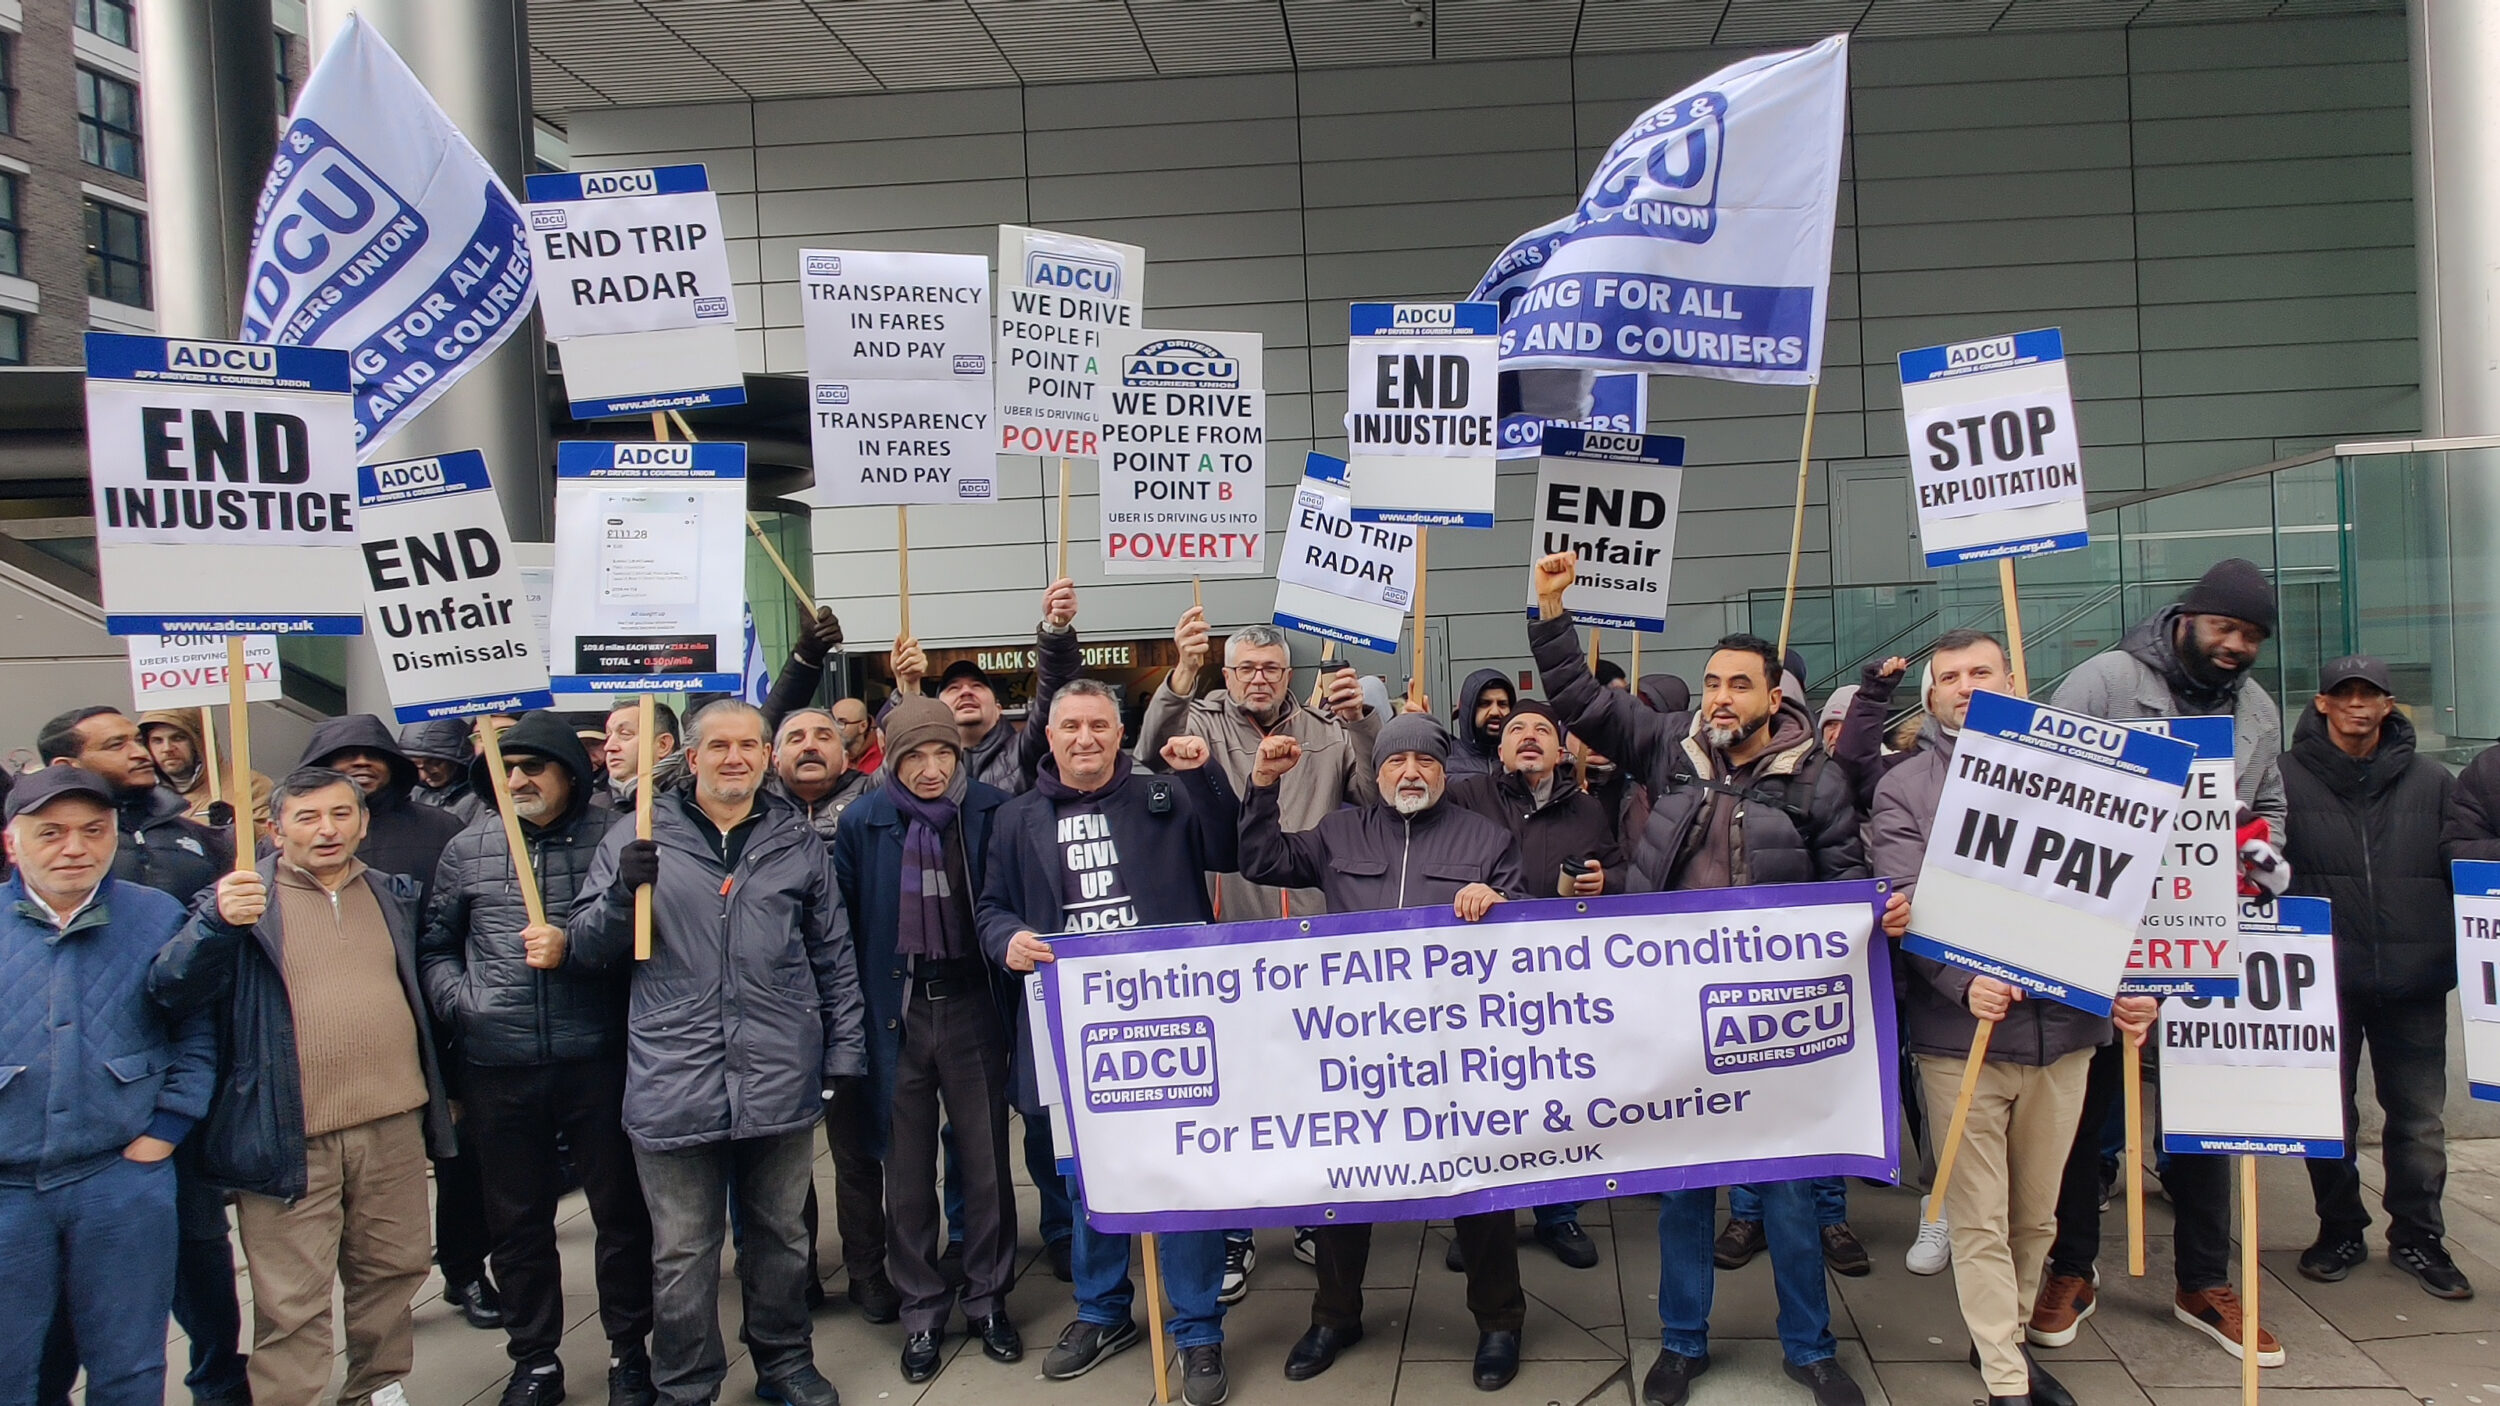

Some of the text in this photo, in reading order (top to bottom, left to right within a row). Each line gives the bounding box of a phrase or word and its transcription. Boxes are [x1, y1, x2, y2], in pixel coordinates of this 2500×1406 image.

[290, 131, 314, 153] &
[586, 174, 652, 194] ADCU
[534, 216, 564, 225] ADCU
[1623, 203, 1709, 229] UNION
[340, 215, 418, 286] UNION
[545, 224, 707, 260] END TRIP
[809, 262, 839, 270] ADCU
[1035, 263, 1112, 292] ADCU
[382, 241, 499, 353] FOR ALL
[571, 271, 700, 306] RADAR
[808, 284, 982, 304] TRANSPARENCY
[1595, 279, 1672, 313] FOR
[1679, 288, 1742, 319] ALL
[697, 303, 726, 312] ADCU
[1012, 291, 1130, 326] WE DRIVE
[1396, 310, 1451, 324] ADCU
[368, 361, 435, 422] AND
[435, 224, 530, 360] COURIERS
[851, 313, 945, 330] IN FARES
[1003, 321, 1078, 345] PEOPLE
[853, 341, 945, 358] AND PAY
[1168, 340, 1218, 358] DRIVERS
[1523, 322, 1602, 351] AND
[1617, 328, 1802, 364] COURIERS
[1951, 341, 2011, 365] ADCU
[173, 347, 271, 371] ADCU
[1011, 348, 1098, 375] POINT A
[1129, 361, 1232, 377] ADCU
[221, 376, 274, 386] COURIERS
[277, 380, 310, 388] UNION
[1028, 377, 1095, 400] POINT
[1136, 380, 1197, 388] COURIERS
[1377, 354, 1469, 409] END
[608, 393, 711, 412] www.adcu.org.uk
[1004, 406, 1032, 416] UBER
[1035, 408, 1044, 417] IS
[1047, 409, 1090, 422] DRIVING
[1112, 393, 1251, 417] WE DRIVE
[817, 413, 987, 429] TRANSPARENCY
[1354, 414, 1492, 446] INJUSTICE
[142, 407, 310, 484] END
[1003, 425, 1097, 454] POVER
[1103, 424, 1262, 444] PEOPLE FROM
[1585, 436, 1640, 451] ADCU
[1927, 406, 2056, 472] STOP
[618, 449, 688, 464] ADCU
[859, 440, 950, 456] IN FARES
[1113, 452, 1252, 473] POINT A TO
[381, 463, 439, 488] ADCU
[861, 467, 951, 483] AND PAY
[1920, 463, 2077, 508] EXPLOITATION
[1134, 481, 1232, 500] POINT B
[104, 488, 353, 532] INJUSTICE
[1109, 513, 1257, 523] UBER IS DRIVING US INTO
[1546, 483, 1666, 529] END
[1379, 513, 1464, 524] www.adcu.org.uk
[1300, 509, 1413, 553] END TRIP
[1109, 533, 1259, 558] POVERTY
[1544, 532, 1661, 567] Unfair
[1959, 539, 2056, 561] www.adcu.org.uk
[362, 527, 500, 592] END
[1305, 545, 1394, 585] RADAR
[1575, 573, 1657, 592] missals
[163, 620, 313, 632] www.adcu.org.uk
[379, 593, 513, 638] Unfair
[1298, 622, 1371, 646] www.adcu.org.uk
[140, 657, 168, 666] UBER
[182, 652, 227, 662] DRIVING
[245, 648, 270, 657] INTO
[393, 639, 527, 672] Dismissals
[978, 652, 1023, 670] BLACK
[1080, 647, 1130, 666] COFFEE
[590, 678, 702, 689] www.adcu.org.uk
[428, 697, 521, 717] www.adcu.org.uk
[2034, 716, 2122, 750] ADCU
[1999, 730, 2017, 740] APP
[2019, 734, 2058, 751] DRIVERS
[2068, 747, 2115, 768] COURIERS
[2116, 759, 2148, 774] UNION
[1960, 754, 2168, 833] TRANSPARENCY
[1057, 814, 1110, 843] NEV
[1955, 808, 2134, 900] IN PAY
[2175, 843, 2218, 866] TO
[1080, 871, 1113, 899] UP
[2174, 877, 2192, 899] B
[1064, 905, 1139, 933] ADCU
[2164, 916, 2184, 926] US
[2190, 915, 2226, 926] INTO
[1082, 926, 1849, 1010] Fighting for FAIR Pay and Conditions
[1944, 950, 2067, 998] www.adcu.org.uk
[1707, 980, 1846, 1004] APP DRIVERS &
[1292, 991, 1615, 1040] Workers Rights
[1714, 1002, 1843, 1047] ADCU
[1087, 1022, 1207, 1042] APP DRIVERS &
[2167, 1021, 2335, 1051] EXPLOITATION
[1713, 1035, 1848, 1067] COURIERS UNION
[1092, 1046, 1207, 1082] ADCU
[1320, 1046, 1596, 1099] Digital Rights
[1091, 1084, 1213, 1105] COURIERS UNION
[1175, 1087, 1751, 1155] For EVERY Driver & Courier
[2201, 1139, 2306, 1153] www.adcu.org.uk
[1327, 1143, 1604, 1189] WWW.ADCU.ORG.UK
